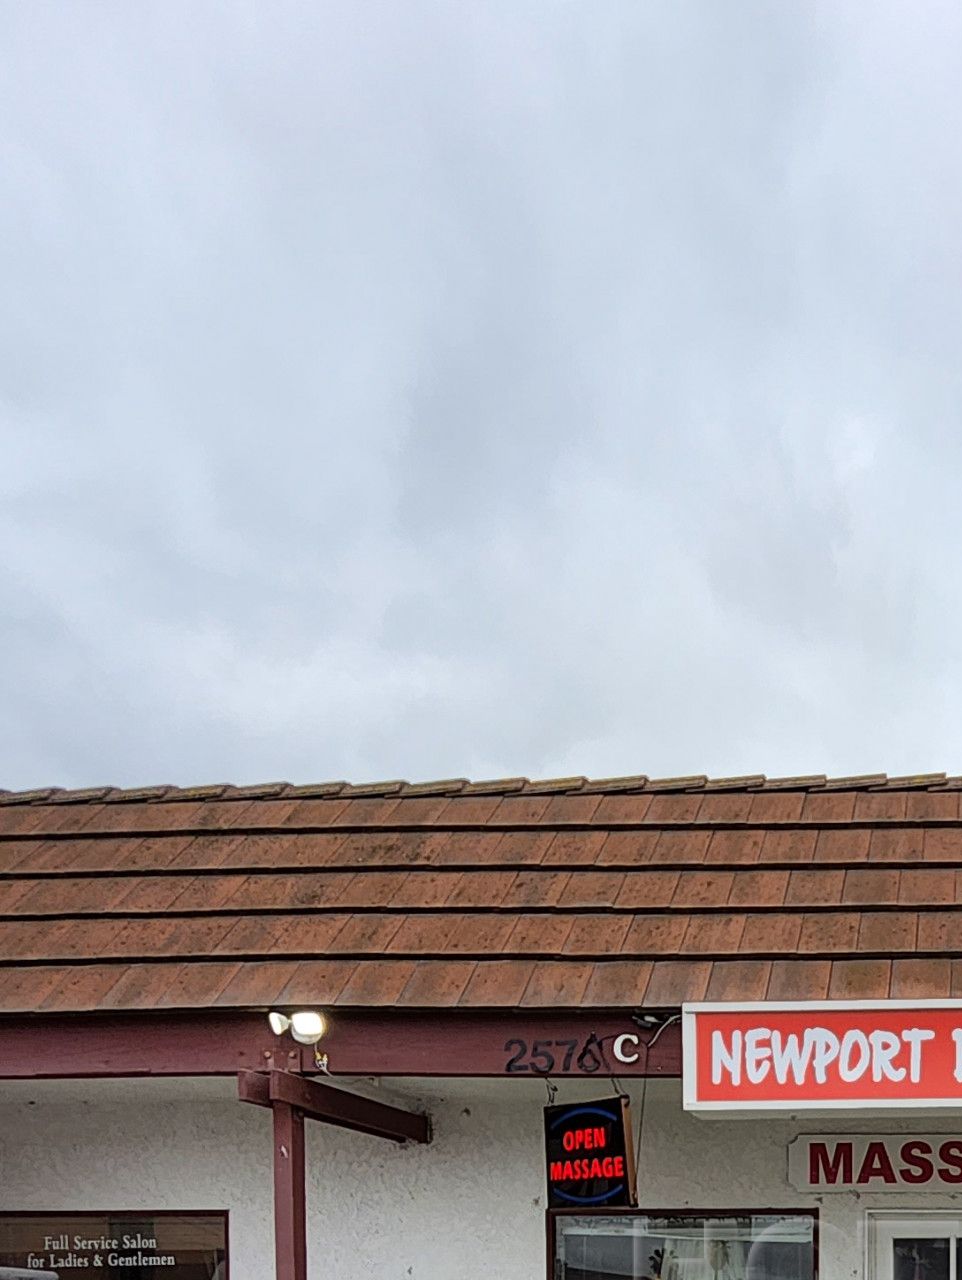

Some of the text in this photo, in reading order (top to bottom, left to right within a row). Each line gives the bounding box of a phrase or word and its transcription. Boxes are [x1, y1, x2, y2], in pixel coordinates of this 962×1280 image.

[613, 1033, 639, 1063] C
[711, 1026, 935, 1086] NEWPORT
[563, 1127, 606, 1152] OPEN
[550, 1156, 624, 1181] MASSAGE
[44, 1234, 157, 1250] Full Service Salon
[27, 1251, 175, 1268] for Ladies & Gentlemen
